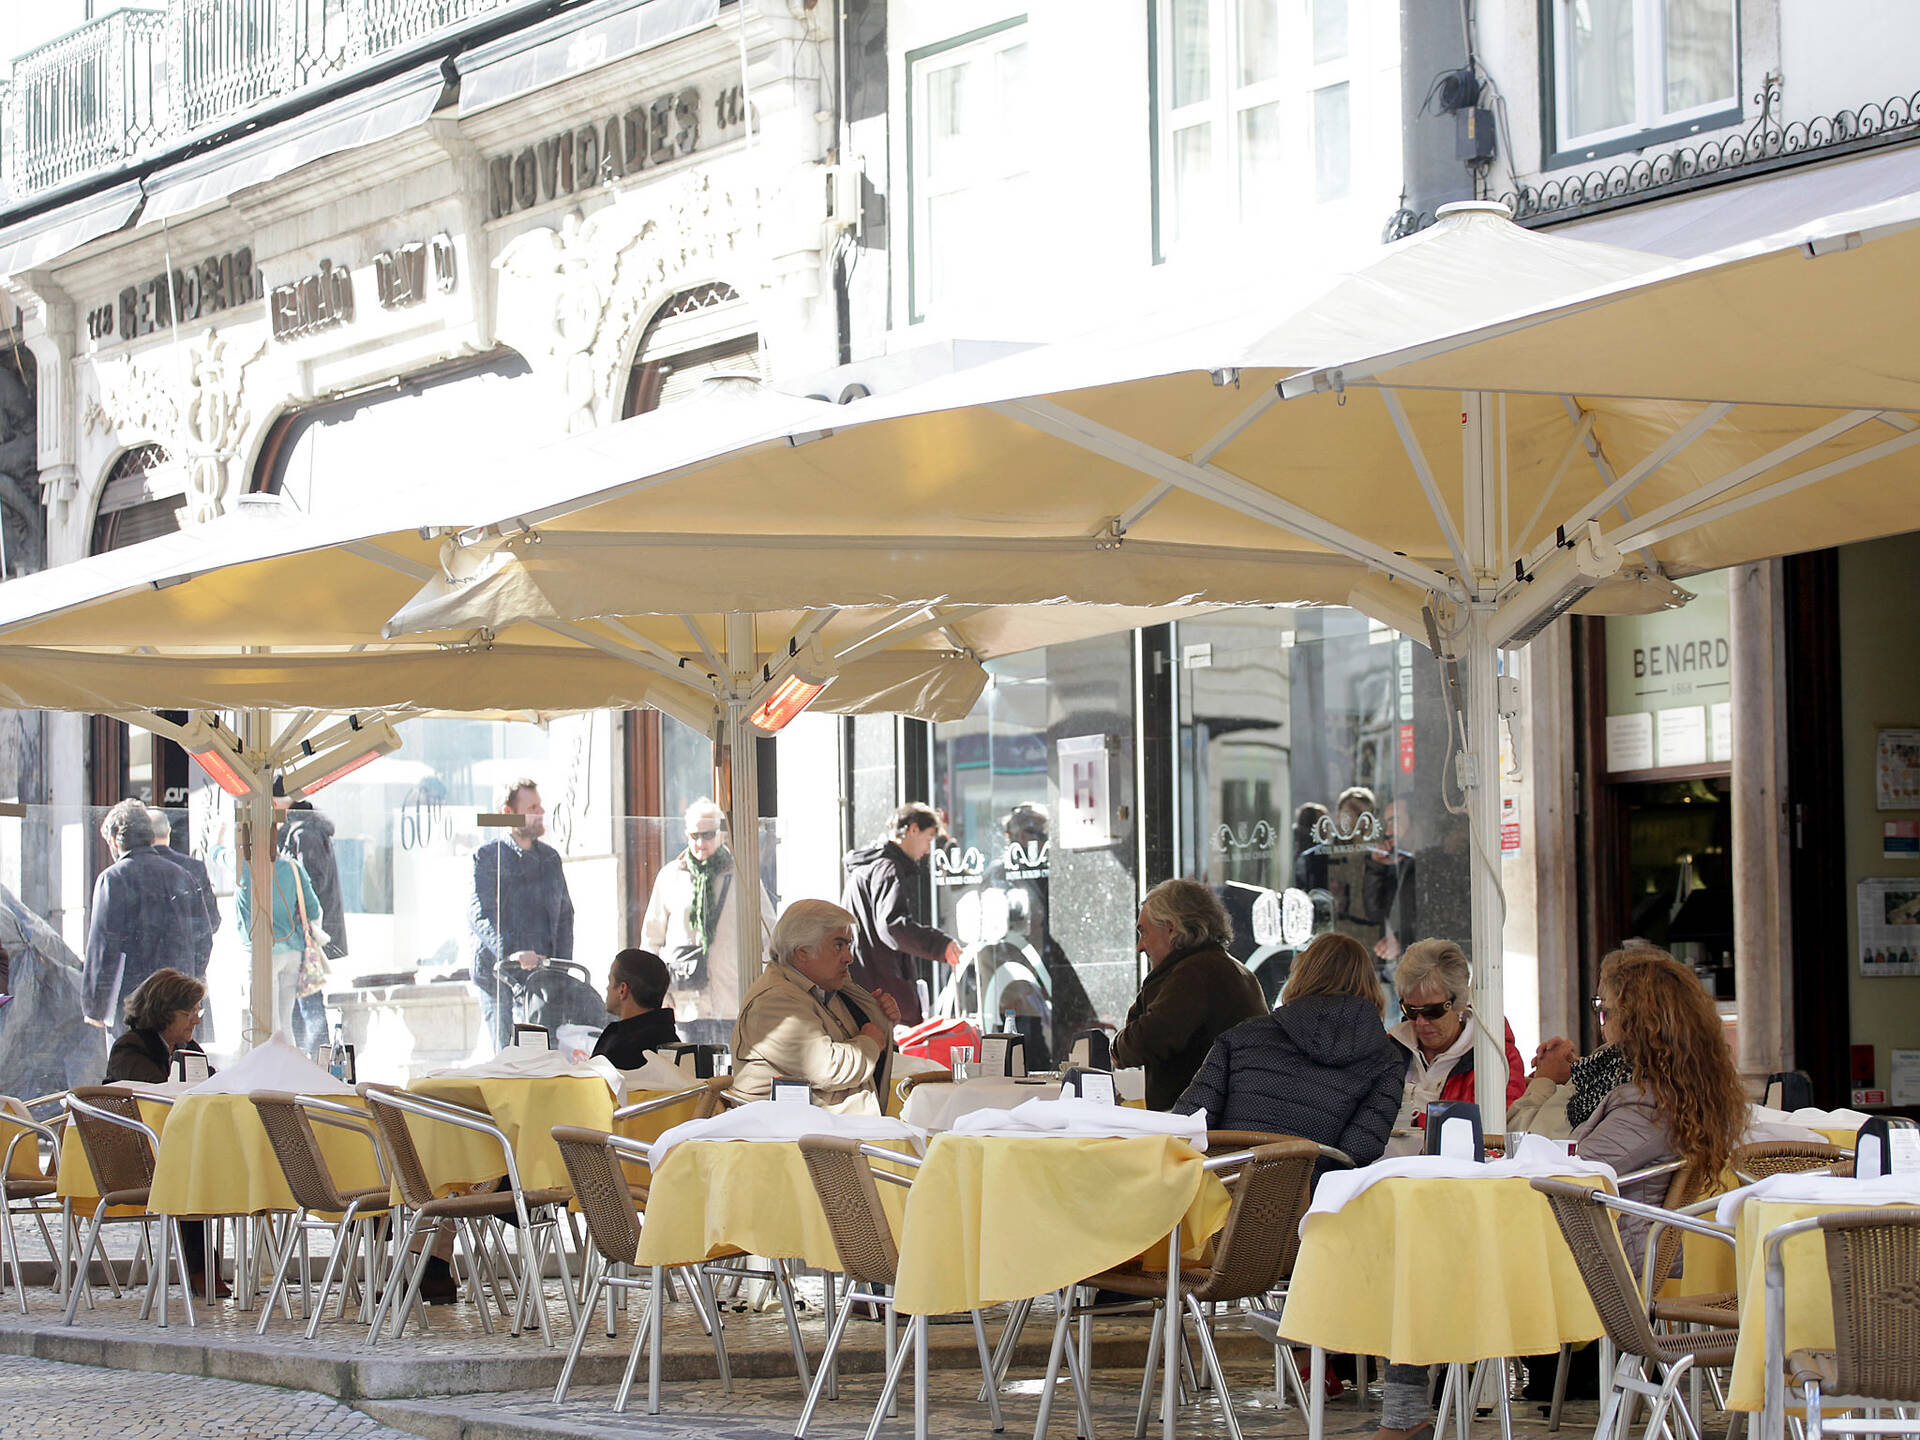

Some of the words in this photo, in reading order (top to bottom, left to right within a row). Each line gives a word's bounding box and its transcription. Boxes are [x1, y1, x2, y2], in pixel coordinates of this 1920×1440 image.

[489, 87, 701, 218] NOVIDADES
[1633, 638, 1729, 678] BENARD
[1073, 761, 1094, 809] H
